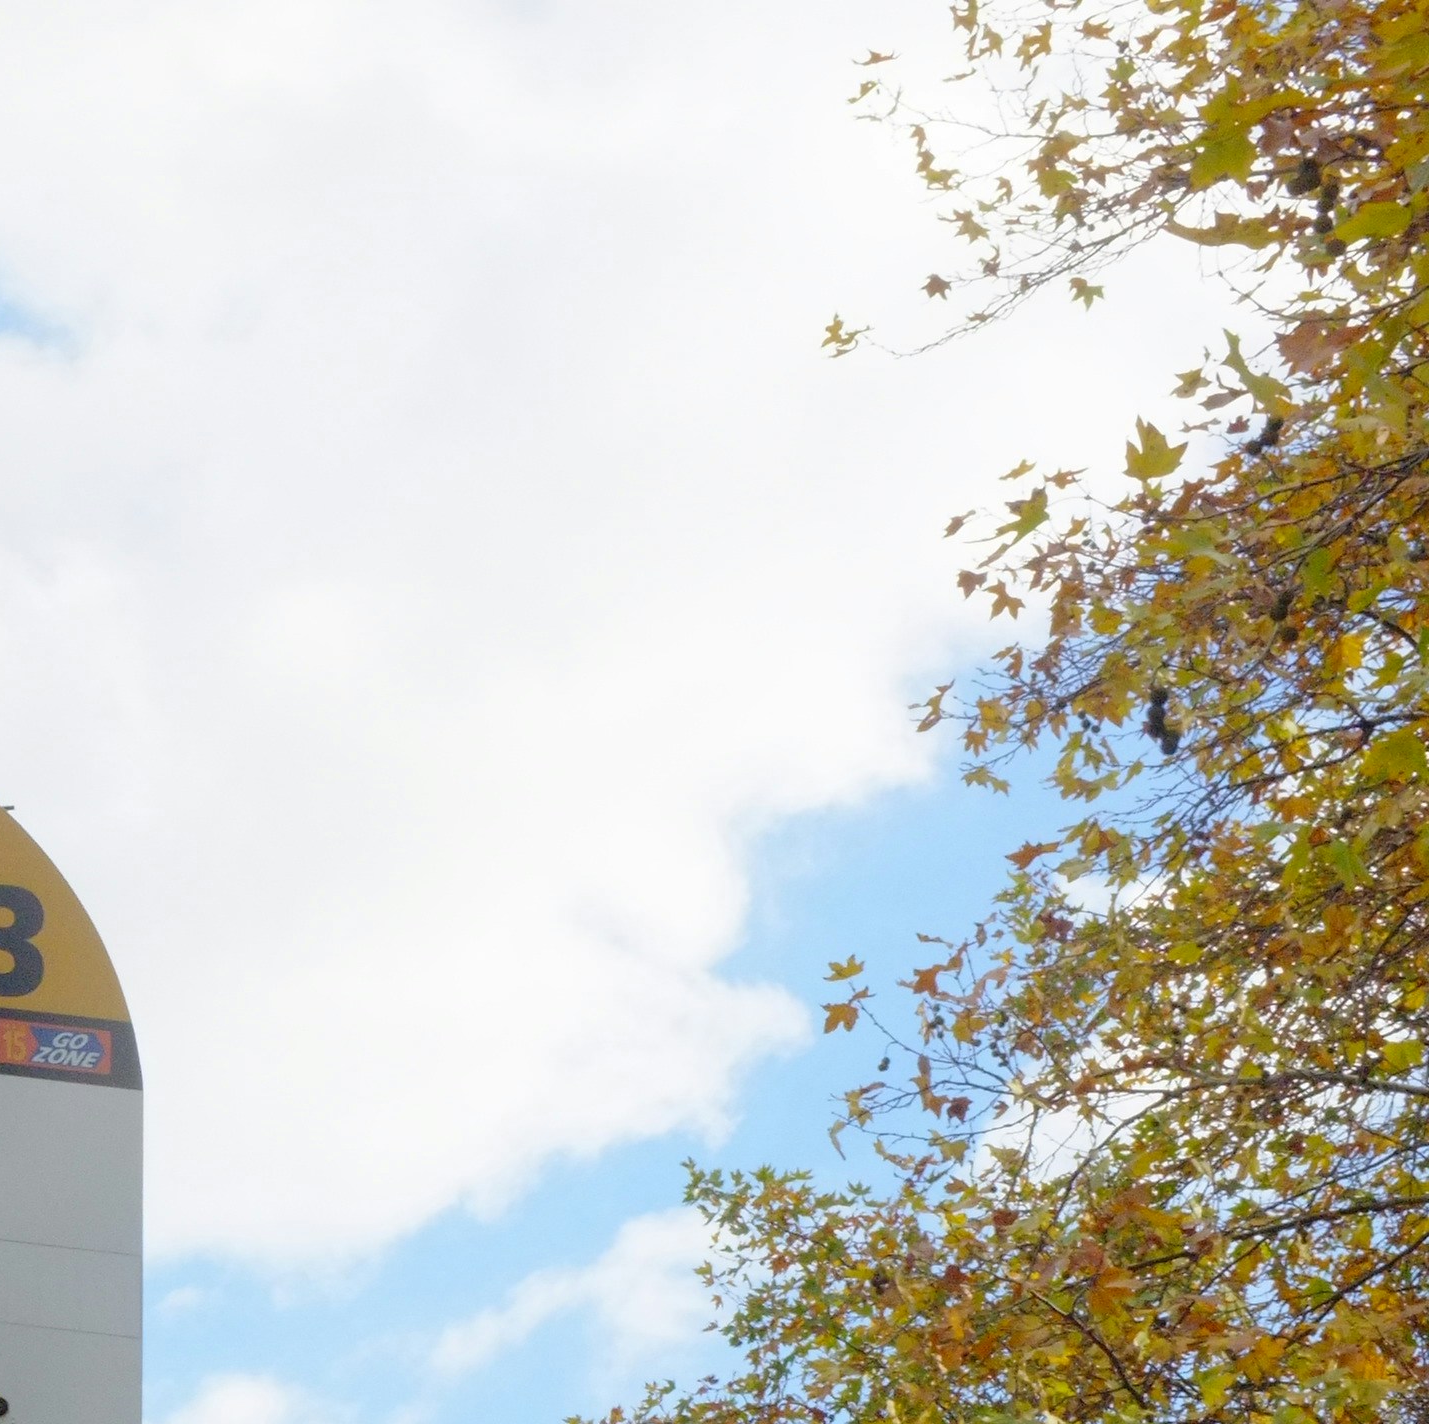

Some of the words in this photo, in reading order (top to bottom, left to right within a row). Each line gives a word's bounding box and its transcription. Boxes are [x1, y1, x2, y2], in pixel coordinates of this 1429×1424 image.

[3, 1026, 28, 1062] 15
[52, 1031, 89, 1050] GO
[31, 1046, 101, 1069] ZONE
